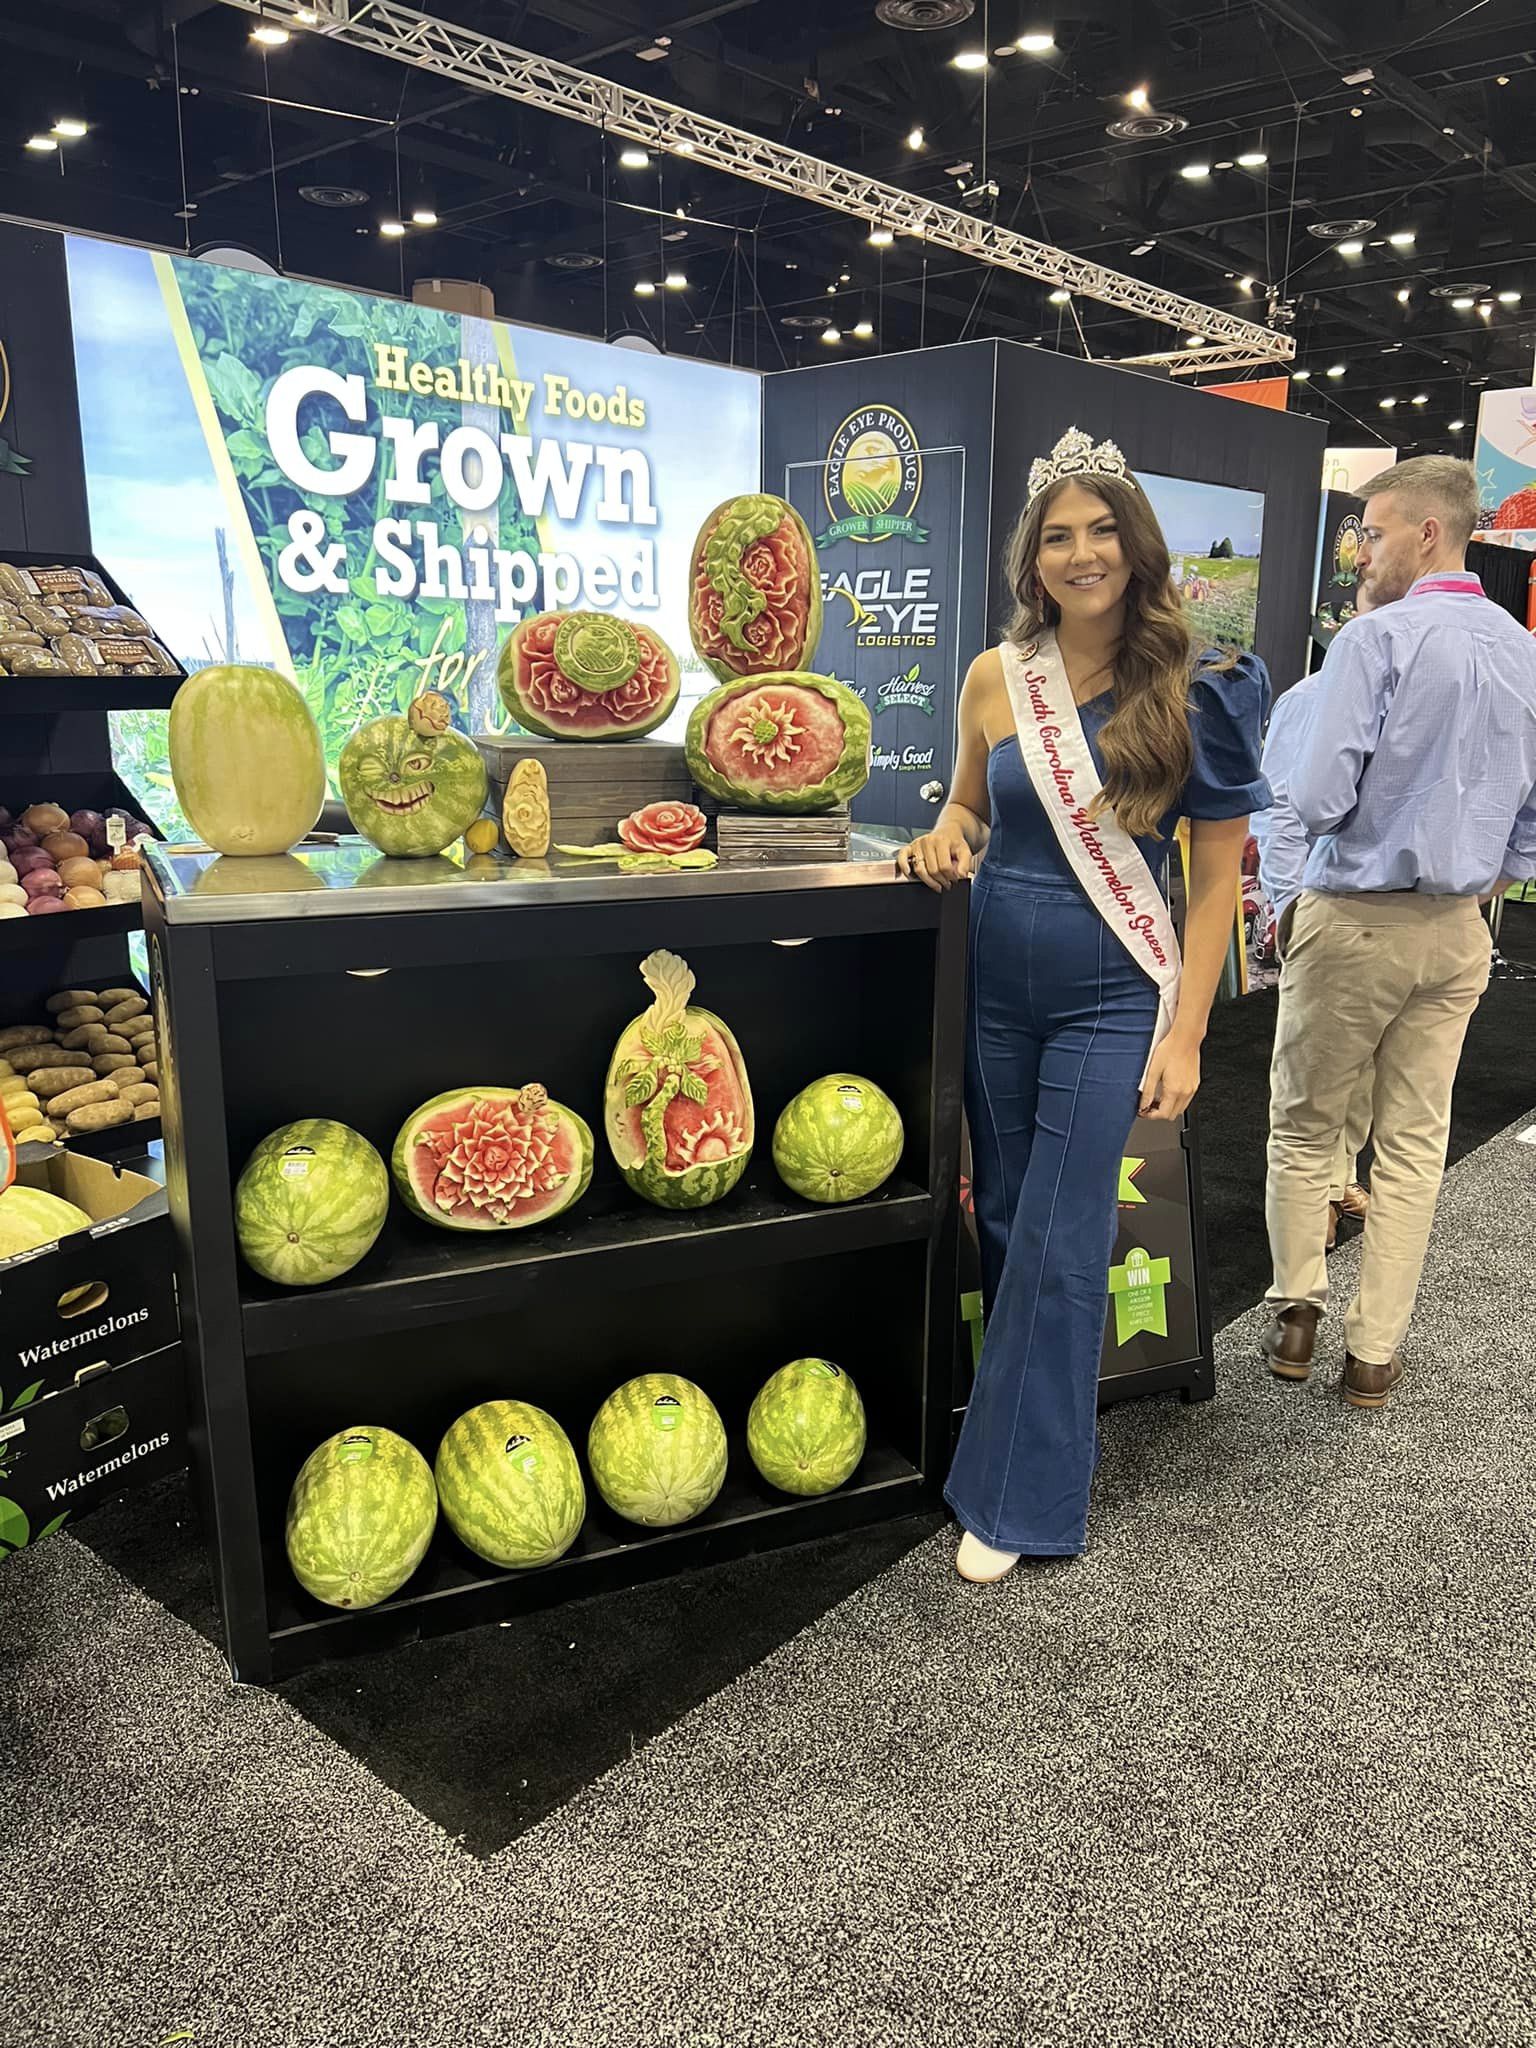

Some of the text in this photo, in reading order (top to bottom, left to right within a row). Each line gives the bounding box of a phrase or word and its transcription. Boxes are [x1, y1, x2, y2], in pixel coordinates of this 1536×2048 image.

[373, 343, 647, 428] Healthy Foods
[265, 364, 658, 526] Grown
[828, 412, 918, 497] EAGLE EYE PRODUCE
[828, 519, 913, 537] GROWER SHIPPER
[278, 508, 660, 624] & Shipped
[857, 635, 936, 646] LOGISTICS
[858, 603, 939, 633] EYE
[414, 616, 487, 698] for
[878, 675, 936, 696] Harvest
[883, 693, 926, 707] SELECT
[869, 745, 934, 771] Simply Good
[1024, 670, 1168, 967] South Carolina Watermelon Queen
[1127, 1266, 1151, 1287] WIN
[18, 1306, 149, 1368] Watermelons
[46, 1432, 170, 1502] Watermelons
